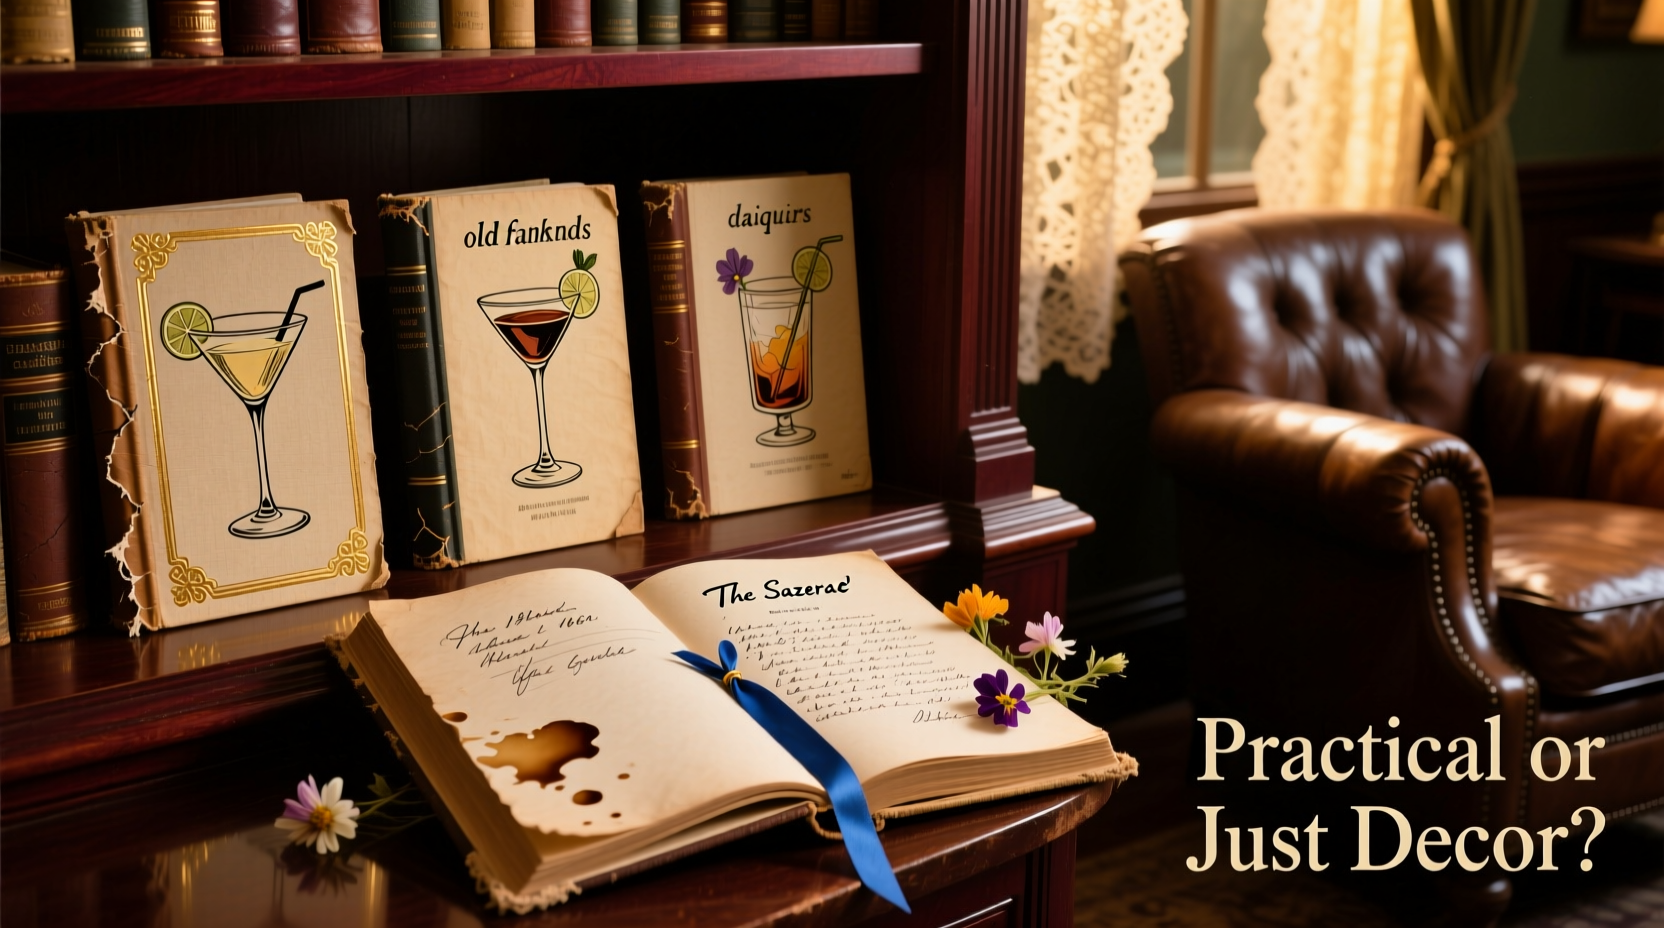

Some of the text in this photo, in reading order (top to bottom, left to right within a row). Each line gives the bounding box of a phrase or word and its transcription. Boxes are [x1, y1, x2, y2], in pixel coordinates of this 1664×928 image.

[463, 214, 591, 249] old fanknds
[728, 203, 811, 235] daiquirs
[701, 581, 757, 609] The
